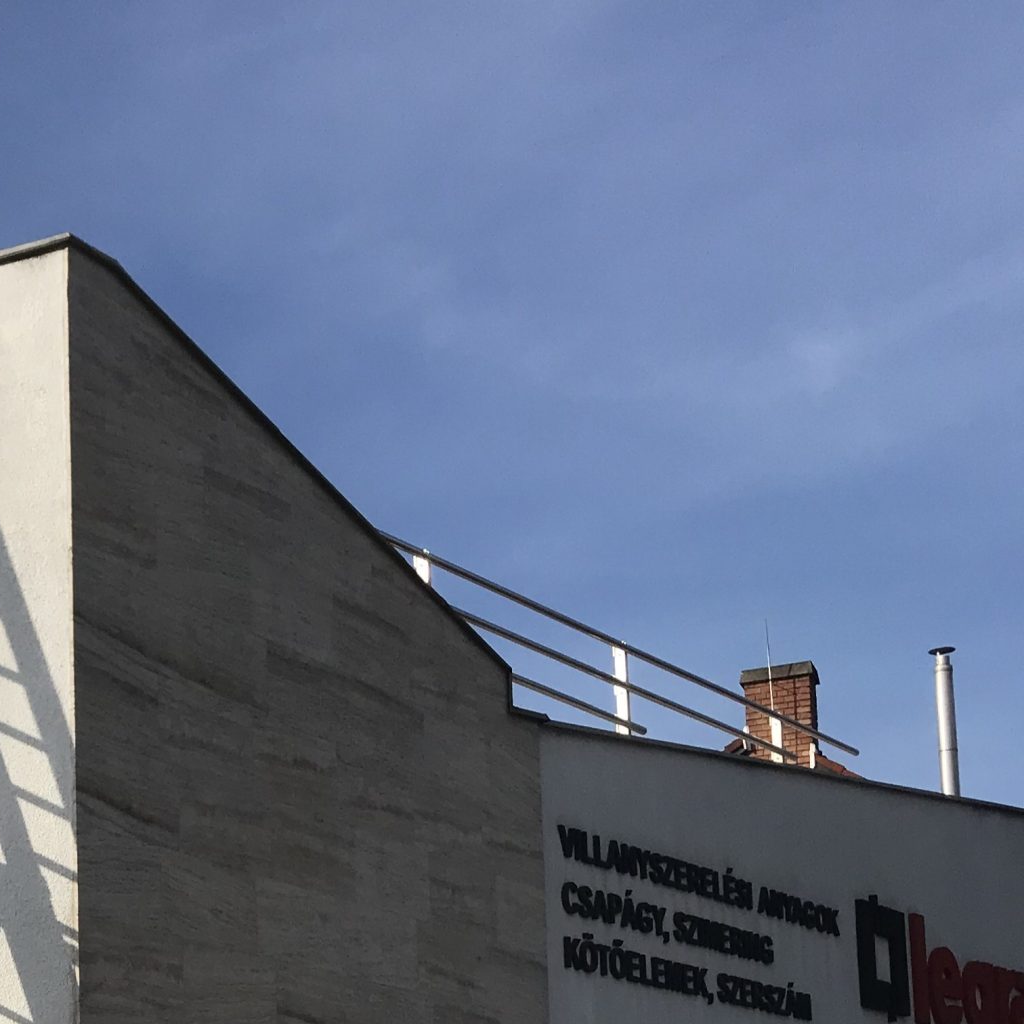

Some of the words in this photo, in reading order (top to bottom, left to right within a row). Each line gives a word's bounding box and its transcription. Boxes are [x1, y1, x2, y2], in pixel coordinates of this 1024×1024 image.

[557, 824, 753, 910] VILLANYSZERELÉSI
[757, 886, 841, 937] ANYAGOK
[561, 881, 670, 944] CSAPÁGY,
[673, 911, 774, 965] SZIMERING
[717, 973, 813, 1020] SZERSZÁM
